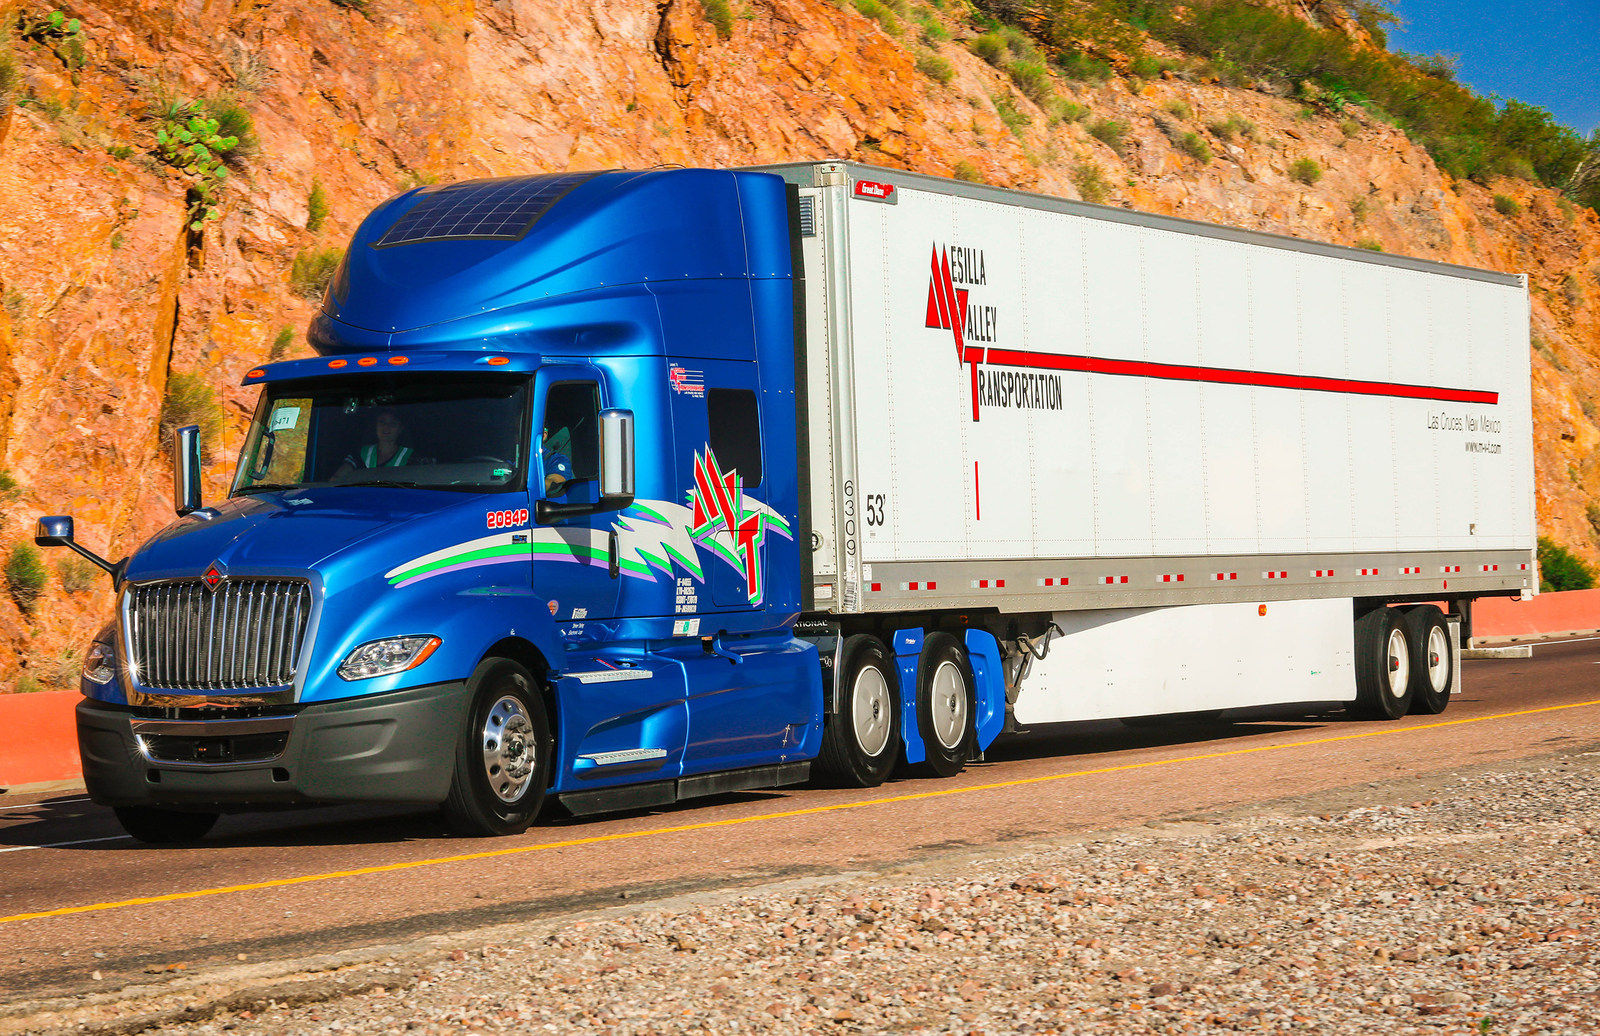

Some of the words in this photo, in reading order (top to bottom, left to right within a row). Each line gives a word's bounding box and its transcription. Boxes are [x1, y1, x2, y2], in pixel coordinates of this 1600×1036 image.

[1427, 410, 1439, 430] Las
[1465, 413, 1479, 432] New
[1480, 414, 1501, 434] Mexico
[487, 509, 529, 529] 2084P
[844, 480, 856, 556] 6309
